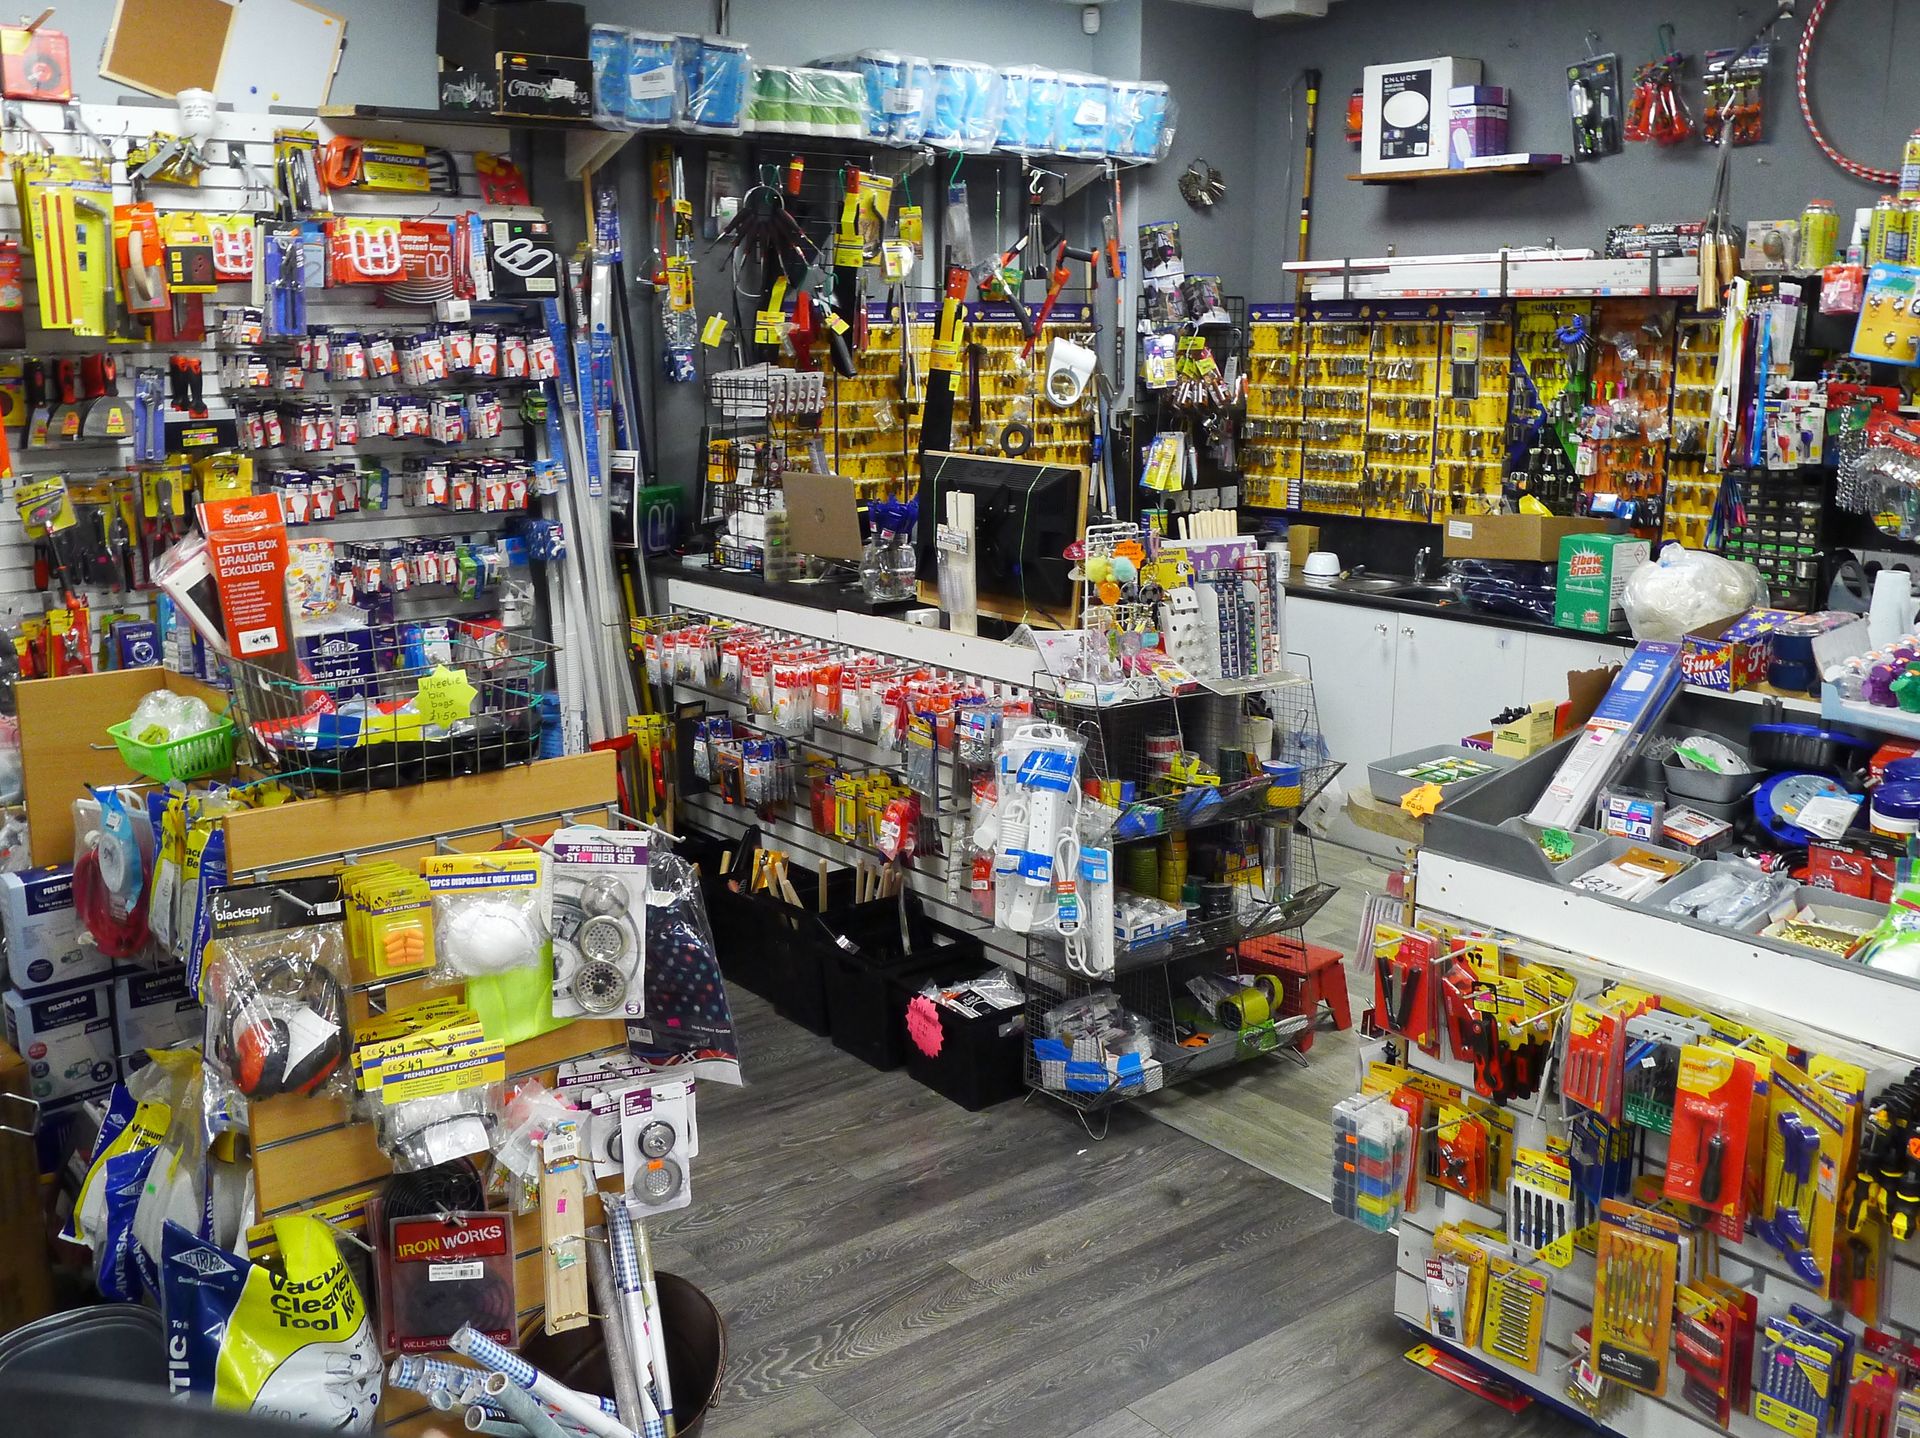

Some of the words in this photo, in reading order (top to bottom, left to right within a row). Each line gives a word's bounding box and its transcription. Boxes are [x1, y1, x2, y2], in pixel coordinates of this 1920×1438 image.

[1384, 74, 1417, 83] ENLUCE
[223, 509, 267, 524] StormSeal
[217, 543, 257, 555] LETTER
[257, 539, 278, 550] BOX
[219, 551, 269, 566] DRAUGHT
[1571, 555, 1604, 566] Elbow
[220, 562, 275, 577] EXCLUDER
[1570, 566, 1602, 576] Grease
[1682, 654, 1715, 674] Fun
[335, 667, 361, 677] Dryer
[1693, 669, 1730, 686] SNAPS
[422, 677, 462, 690] Wheelie
[428, 691, 446, 699] bin
[431, 699, 454, 708] bags
[1406, 800, 1425, 812] each
[566, 853, 615, 863] STINER
[617, 854, 636, 863] SET
[1247, 857, 1260, 868] TAPE
[433, 863, 454, 873] 4.99
[430, 878, 450, 888] 12PCS
[451, 876, 492, 887] DISPOSABLE
[493, 875, 510, 884] DUST
[511, 873, 534, 883] MASKS
[378, 1042, 405, 1058] 5.49
[403, 1068, 434, 1080] PREMIUM
[434, 1063, 458, 1075] SAFETY
[459, 1057, 489, 1069] GOGGLES
[398, 1237, 440, 1257] IRON
[442, 1225, 502, 1249] WORKS
[1427, 1262, 1442, 1270] AUTO
[272, 1309, 338, 1331] Tool
[403, 1340, 449, 1349] WELL-BUI
